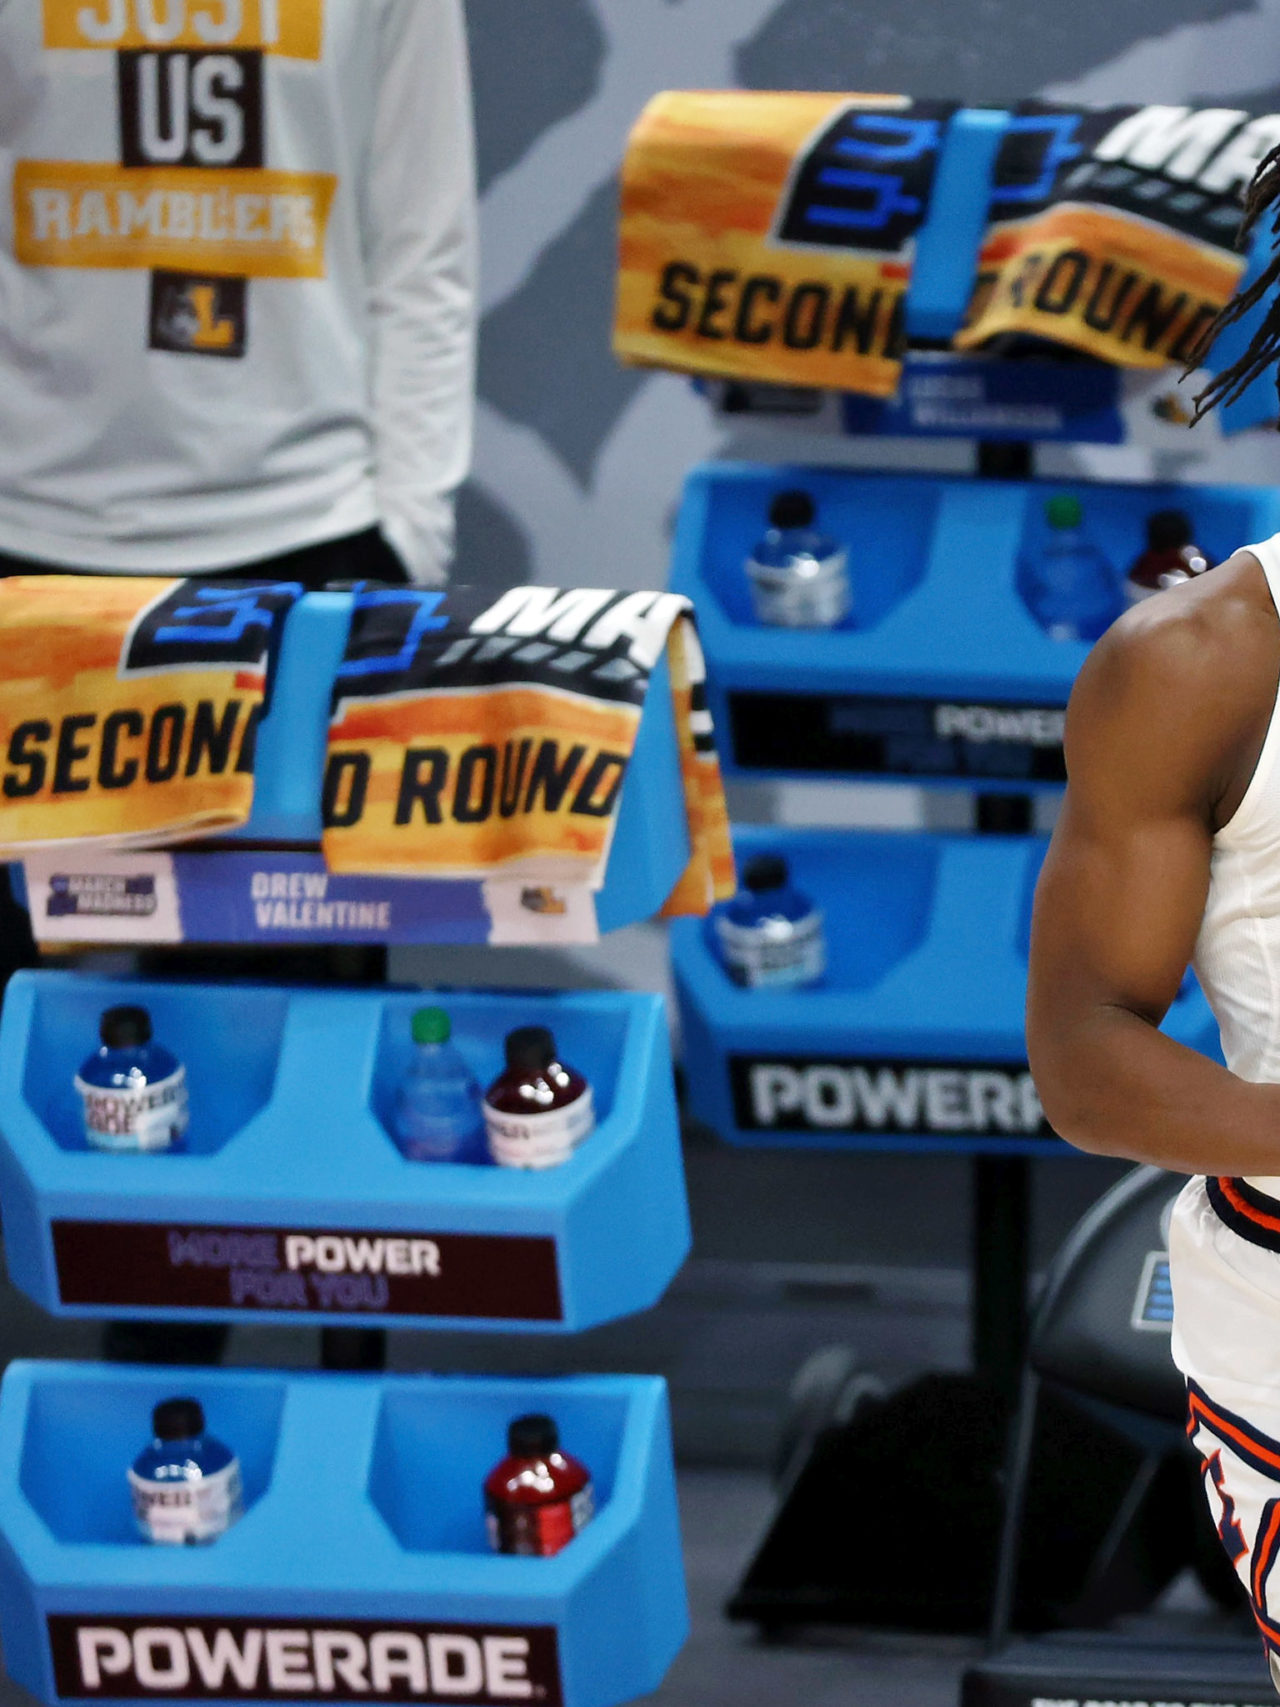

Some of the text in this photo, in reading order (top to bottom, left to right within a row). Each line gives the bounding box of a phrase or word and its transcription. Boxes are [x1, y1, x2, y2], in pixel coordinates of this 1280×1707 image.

[137, 53, 245, 164] US
[468, 585, 694, 670] MA
[933, 703, 1066, 747] POWE
[394, 737, 629, 827] ROUND
[251, 873, 328, 900] DREW
[254, 900, 391, 930] VALENTINE
[166, 1230, 442, 1277] MORE POWER
[228, 1267, 390, 1312] FOR YOU
[76, 1626, 533, 1699] POWERADE
